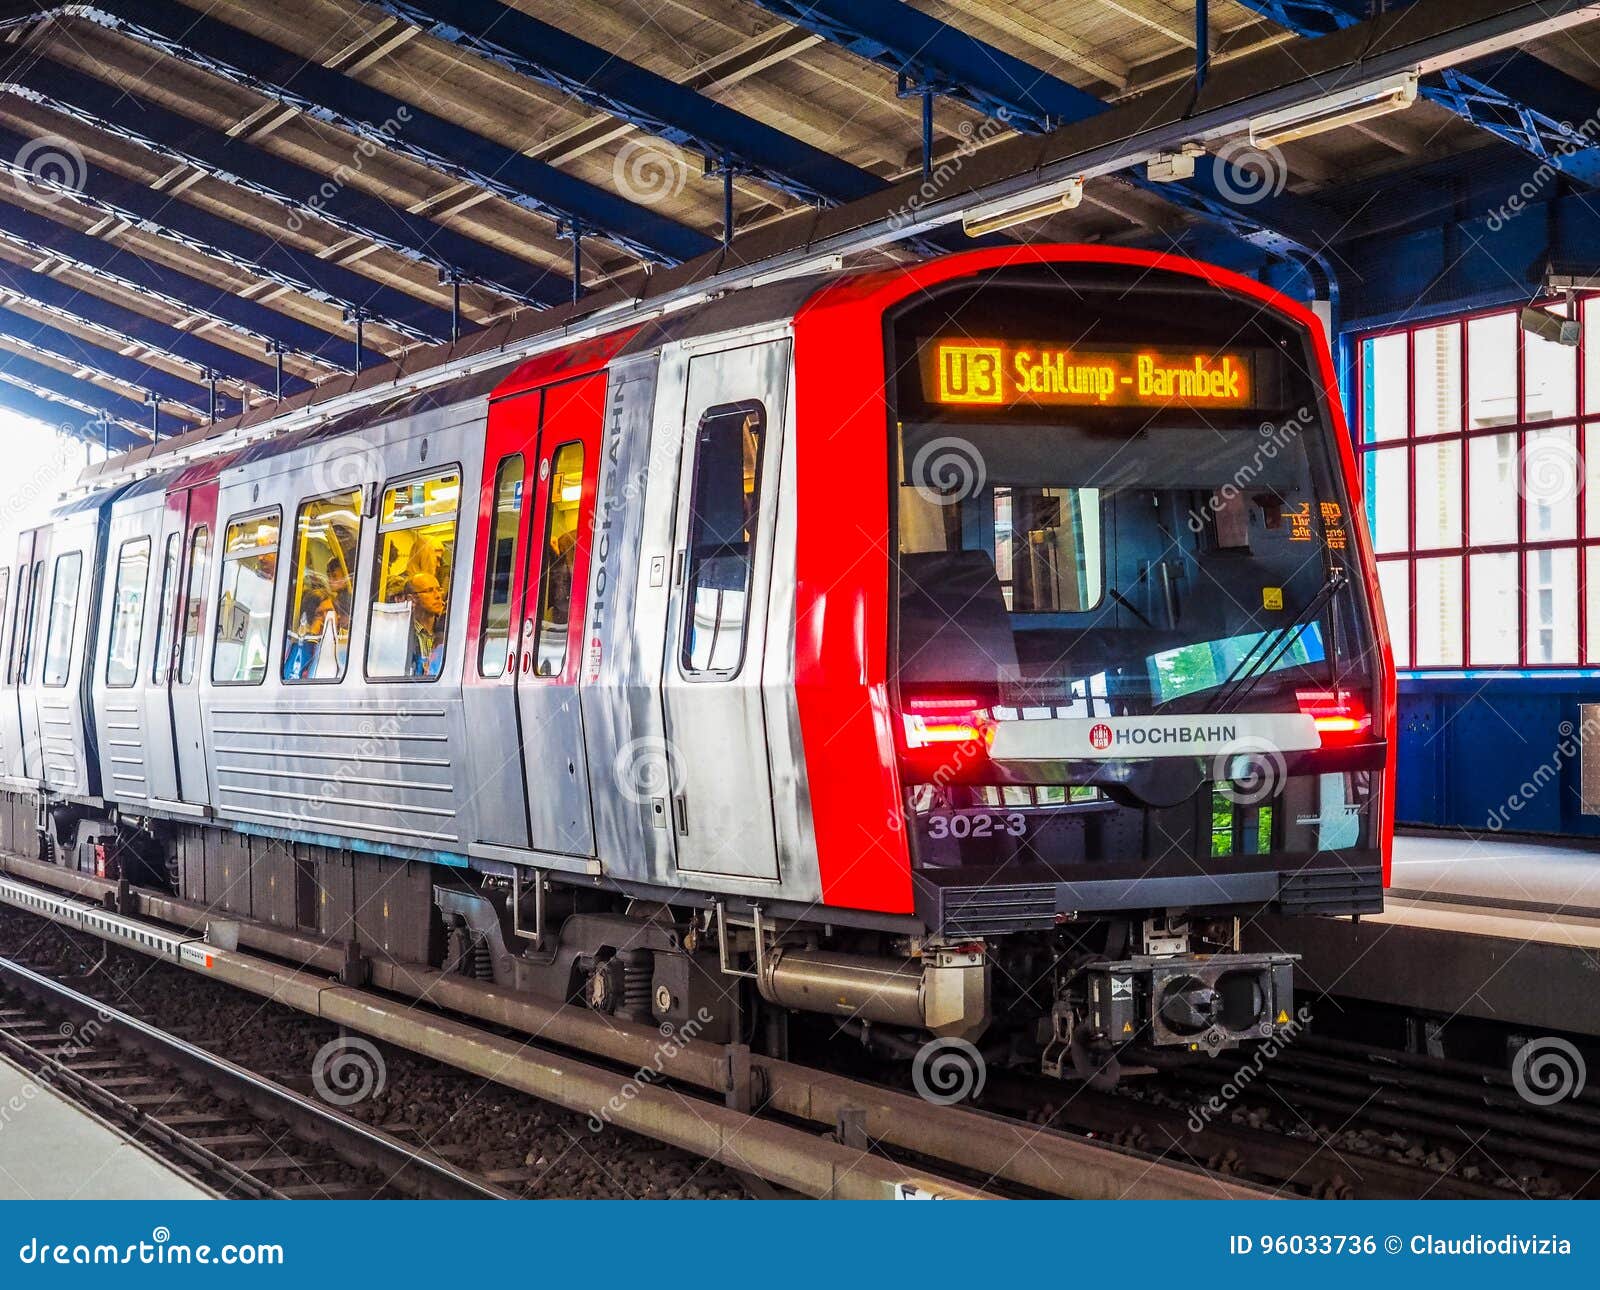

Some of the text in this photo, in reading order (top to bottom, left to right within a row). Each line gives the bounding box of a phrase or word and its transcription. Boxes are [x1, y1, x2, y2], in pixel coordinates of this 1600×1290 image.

[942, 349, 1000, 400] U3
[1014, 351, 1115, 401] Schlump
[1138, 355, 1239, 398] Barmbek
[592, 374, 627, 629] HOCHBAHN
[1116, 726, 1237, 745] HOCHBAHN
[928, 813, 1027, 839] 302-3
